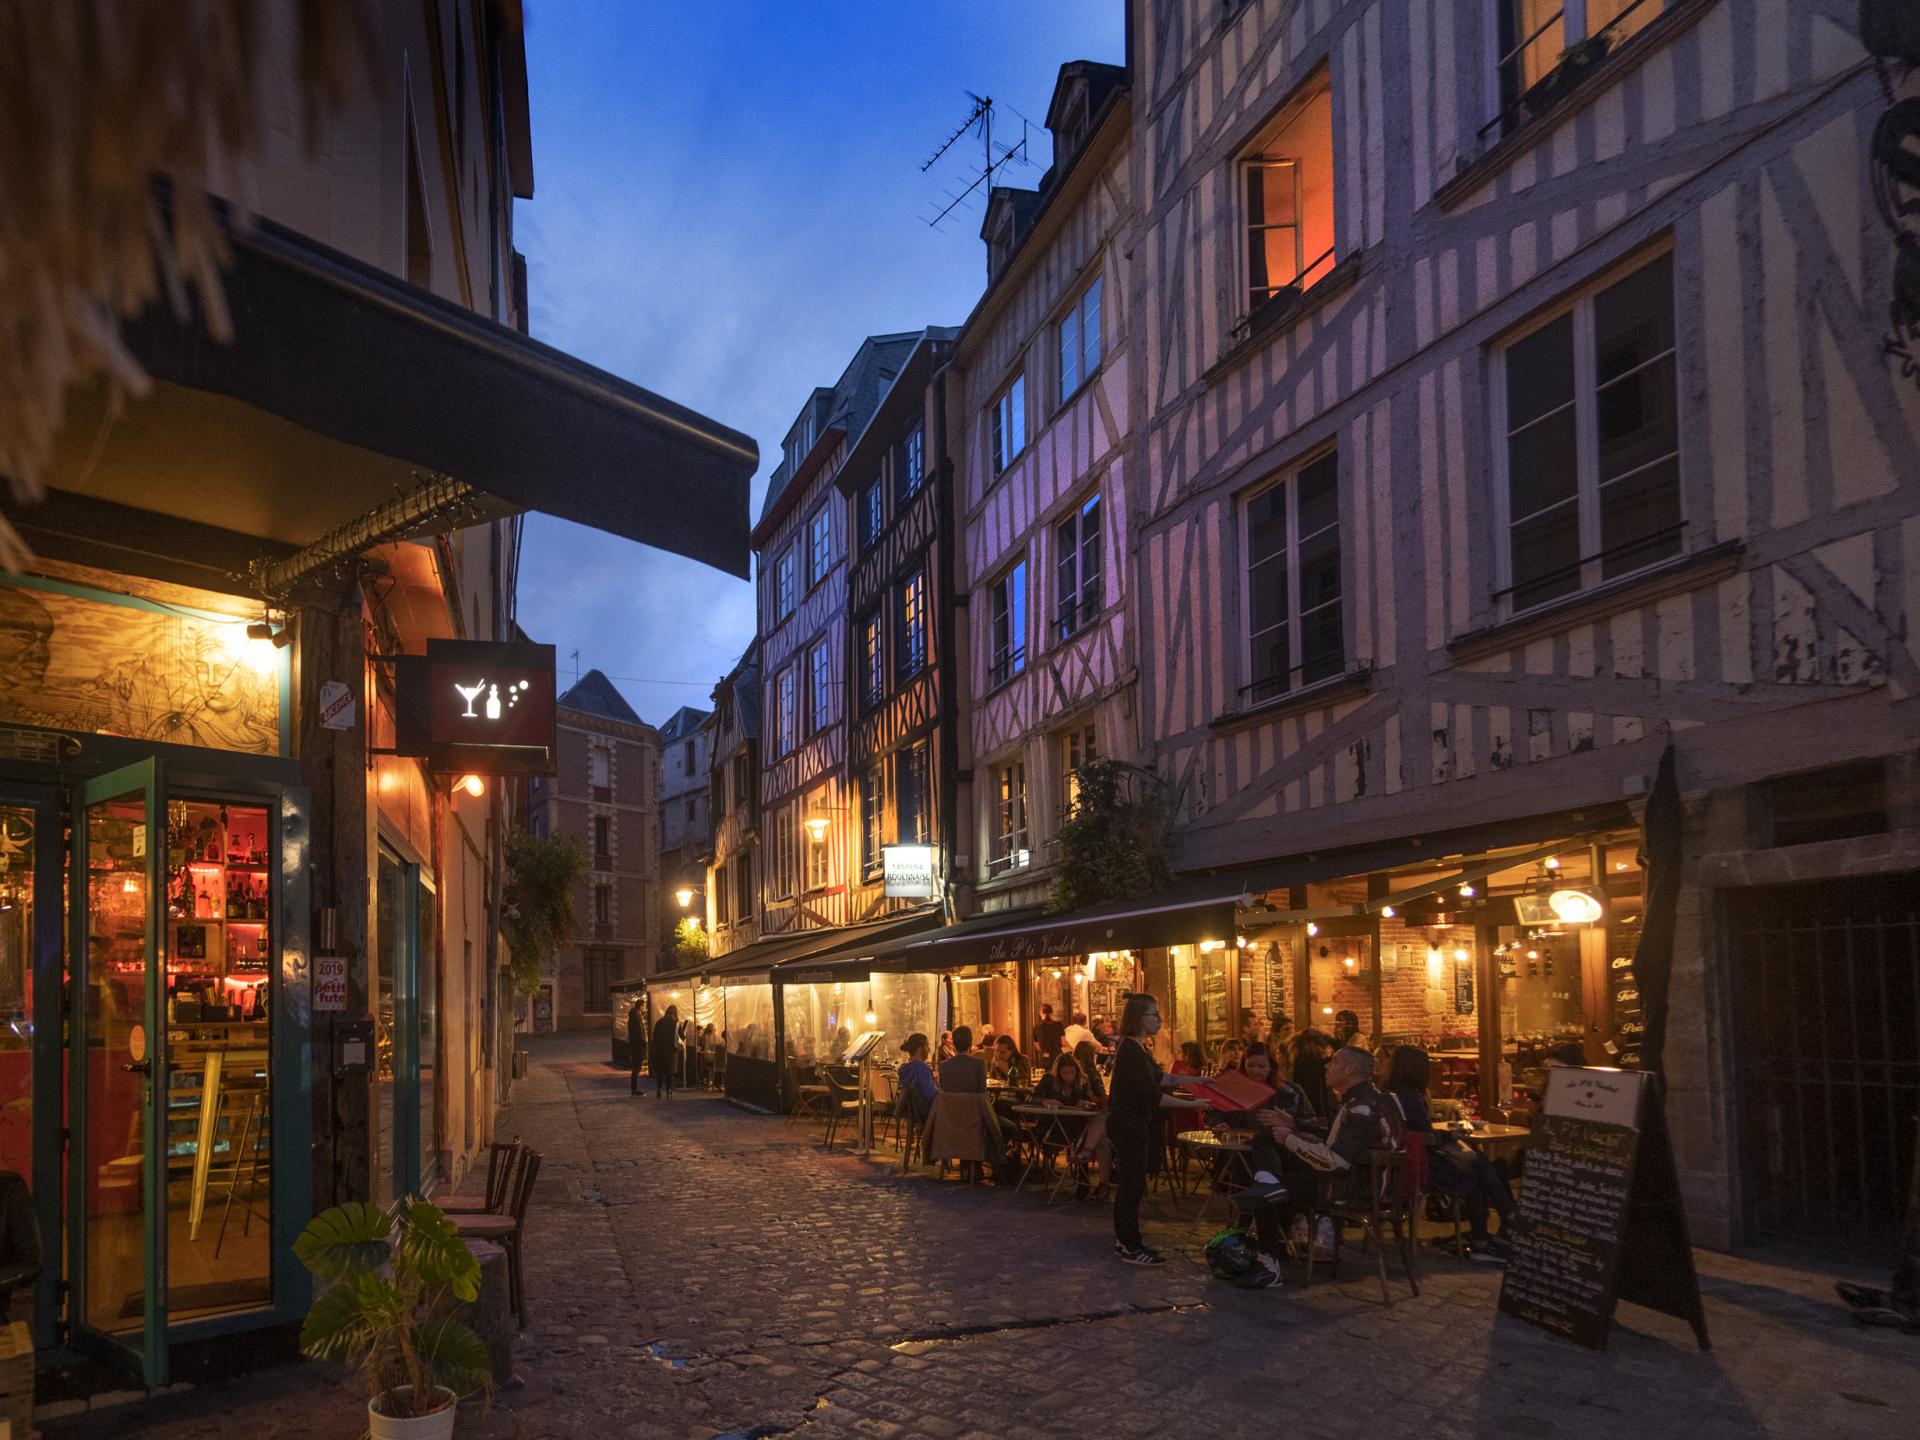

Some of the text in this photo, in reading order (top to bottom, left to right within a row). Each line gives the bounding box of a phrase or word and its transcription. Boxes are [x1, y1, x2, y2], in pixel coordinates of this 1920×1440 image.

[320, 690, 353, 724] LICENCE
[886, 873, 930, 881] ROUENNAISE
[990, 940, 1006, 960] Au
[318, 963, 343, 975] 2019
[314, 982, 346, 996] petit
